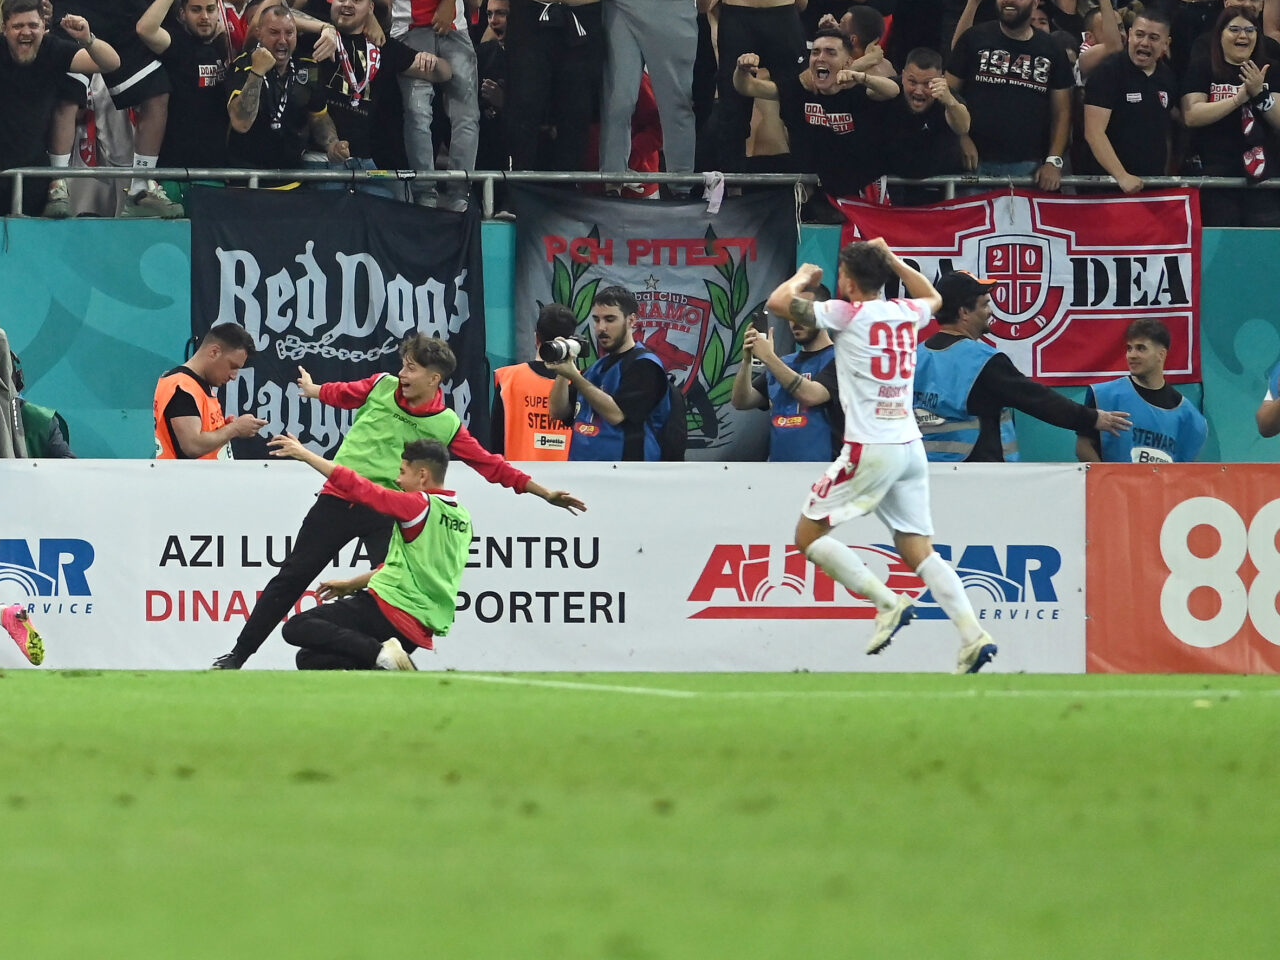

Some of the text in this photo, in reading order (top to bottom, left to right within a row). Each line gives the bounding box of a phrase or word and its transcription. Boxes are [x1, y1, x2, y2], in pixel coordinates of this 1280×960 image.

[975, 74, 1007, 85] DINAMO
[977, 48, 1052, 84] 1948
[543, 234, 614, 266] PCH
[210, 240, 470, 352] Red Dogs
[1069, 256, 1190, 311] DEA
[157, 535, 227, 568] AZI
[978, 608, 1063, 620] ERVICE
